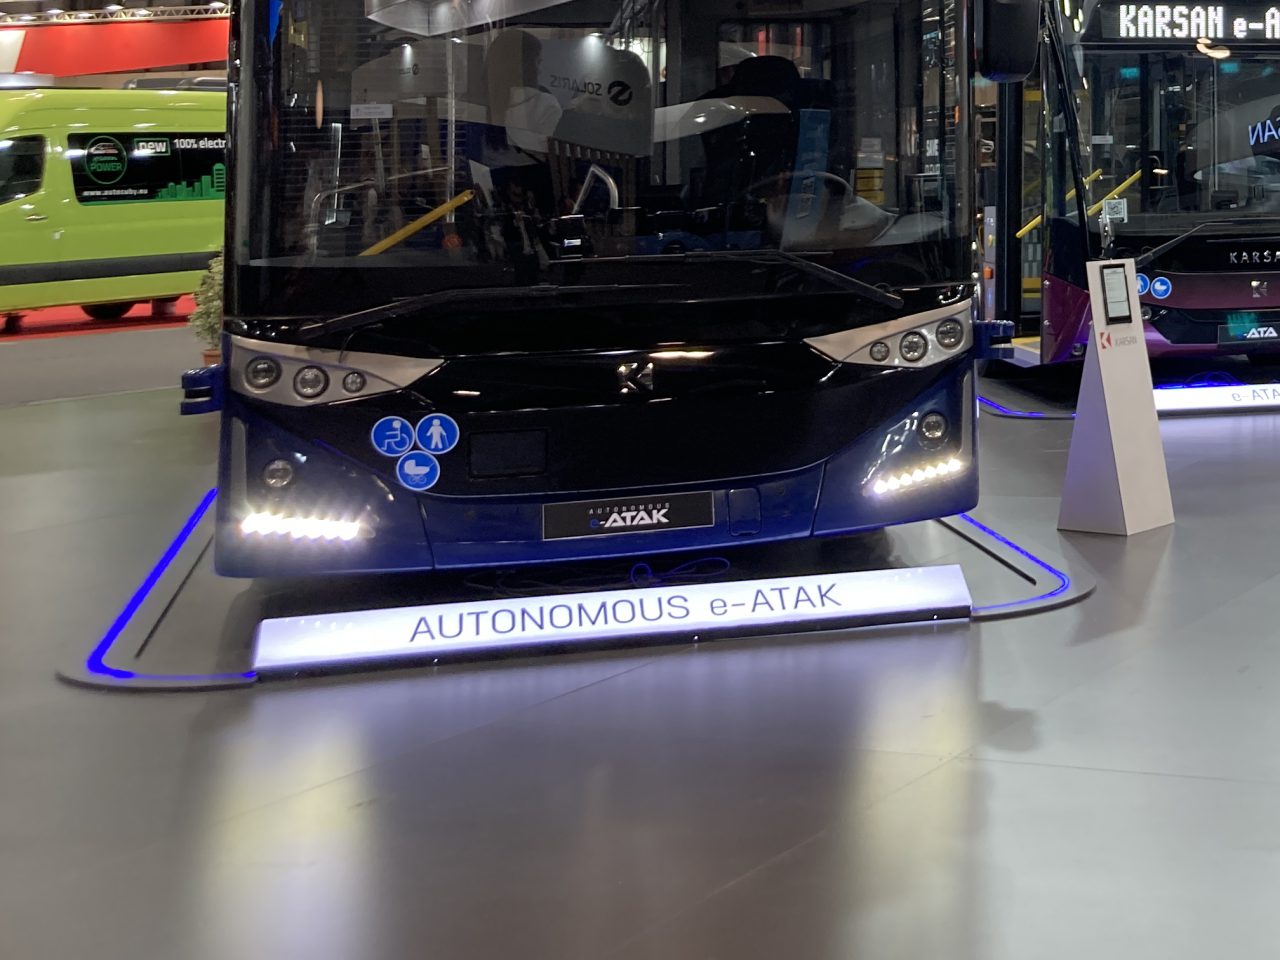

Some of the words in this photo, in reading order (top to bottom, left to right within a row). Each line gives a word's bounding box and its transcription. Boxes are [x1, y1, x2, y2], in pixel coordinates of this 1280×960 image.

[1119, 4, 1224, 38] KARSAN
[138, 141, 167, 153] new
[174, 138, 198, 149] 100%
[90, 162, 123, 172] POWER
[588, 502, 670, 515] AUTONOMOUS
[589, 508, 670, 529] e-ATAK
[410, 594, 691, 642] AUTONOMOUS
[709, 583, 842, 617] e-ATAK
